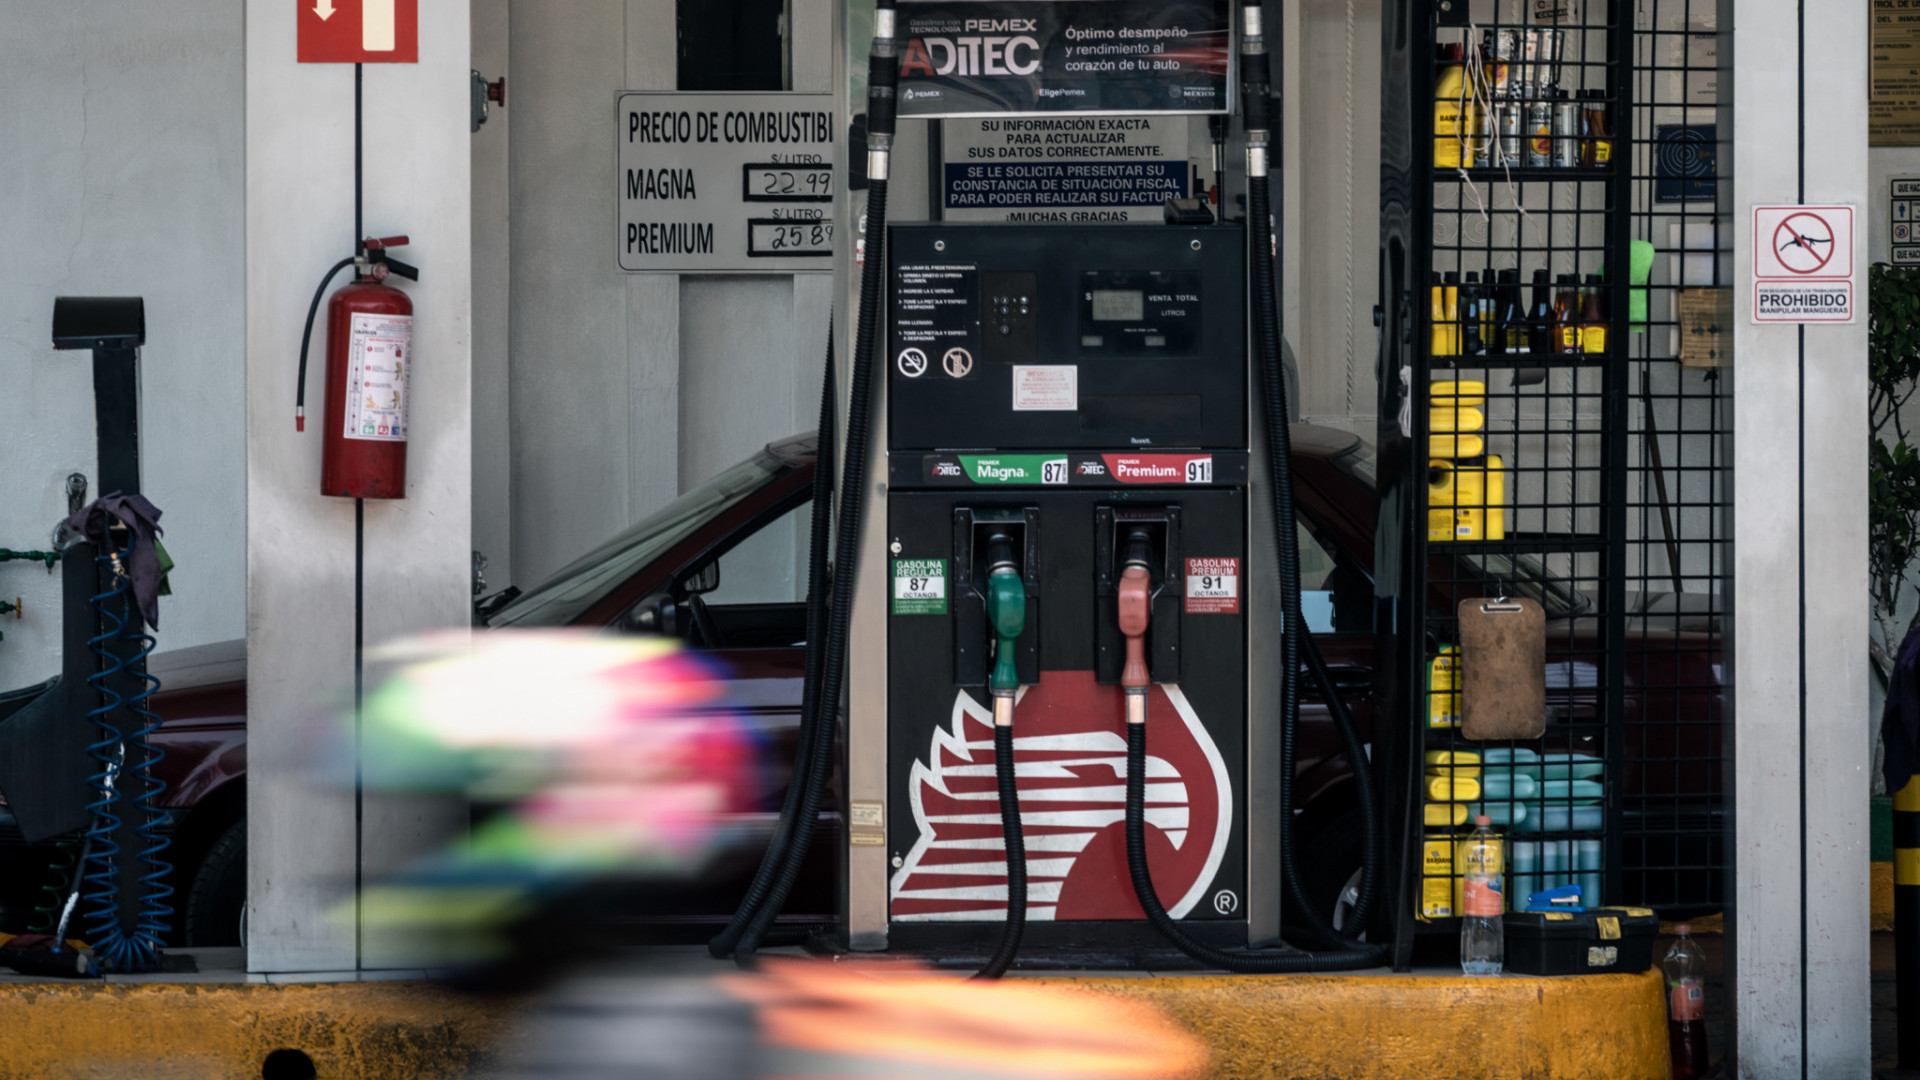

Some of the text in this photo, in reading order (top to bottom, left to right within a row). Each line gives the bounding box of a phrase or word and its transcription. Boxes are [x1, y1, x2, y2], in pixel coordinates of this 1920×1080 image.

[965, 18, 1037, 32] PEMEX
[1065, 25, 1115, 41] Óptimo
[1065, 42, 1165, 58] y rendimiento al
[1065, 59, 1180, 71] corazón de tu auto
[629, 111, 691, 143] PRECIO
[696, 112, 718, 143] DE
[981, 117, 1150, 132] SU INFORMACIÓN EXACTA
[1006, 132, 1126, 145] PARA ACTUALIZAR
[968, 146, 1164, 158] SUS DATOS CORRECTAMENTE.
[967, 164, 1165, 178] SE LE SOLICITA PRESENTAR SU
[627, 168, 696, 200] MAGNA
[764, 172, 831, 194] 22.99
[953, 176, 1180, 191] CONSTANCIA DE SITUACIÓN FISCAL
[950, 191, 1182, 205] PARA PODER REALIZAR SU FACTURA
[1070, 211, 1129, 222] GRACIAS
[627, 223, 714, 254] PREMIUM
[1175, 294, 1199, 302] TOTAL
[1760, 294, 1847, 307] PROHIBIDO
[977, 466, 1024, 481] Magna
[1044, 463, 1062, 482] 87
[1118, 464, 1176, 477] Premium
[1188, 462, 1205, 481] 91
[896, 560, 943, 569] GASOLINA
[1190, 559, 1236, 568] GASOLINA
[896, 569, 943, 577] REGULAR
[1191, 568, 1234, 576] PREMIUM
[910, 577, 929, 591] 87
[1202, 576, 1221, 589] 91
